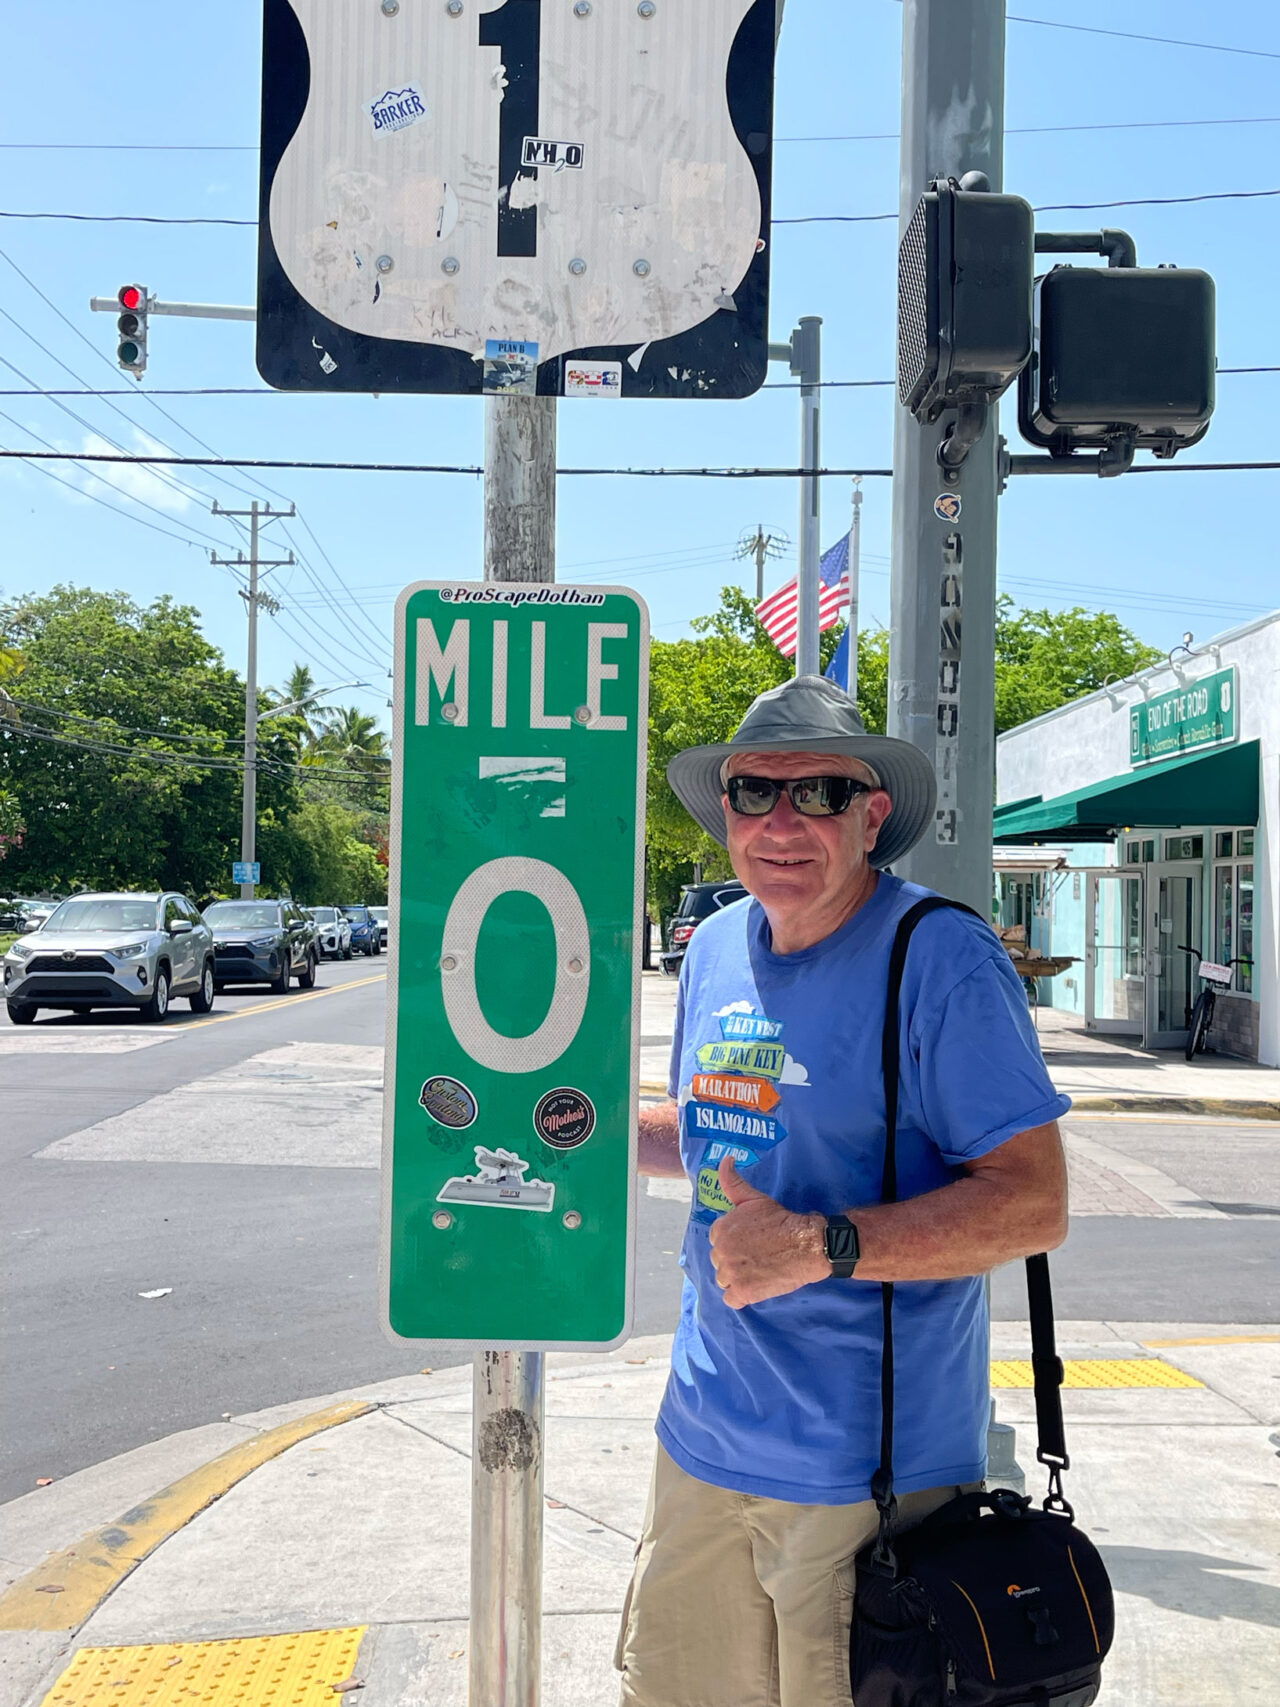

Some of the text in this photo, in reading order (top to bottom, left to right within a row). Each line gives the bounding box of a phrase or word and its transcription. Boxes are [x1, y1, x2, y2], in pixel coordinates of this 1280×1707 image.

[373, 95, 425, 129] BARKER
[479, 0, 541, 257] 1
[498, 343, 517, 353] PLAN
[440, 588, 604, 606] @ProScapeDothan
[415, 617, 628, 731] MILE
[1148, 704, 1161, 732] END
[1162, 700, 1171, 727] OF
[1173, 695, 1186, 723] THE
[1187, 688, 1208, 719] ROAD
[732, 1016, 754, 1034] KEY
[756, 1019, 782, 1037] WEST
[709, 1046, 781, 1071] BIG PINE KEY
[698, 1077, 761, 1105] MARATHON
[557, 1125, 582, 1138] PODCAST
